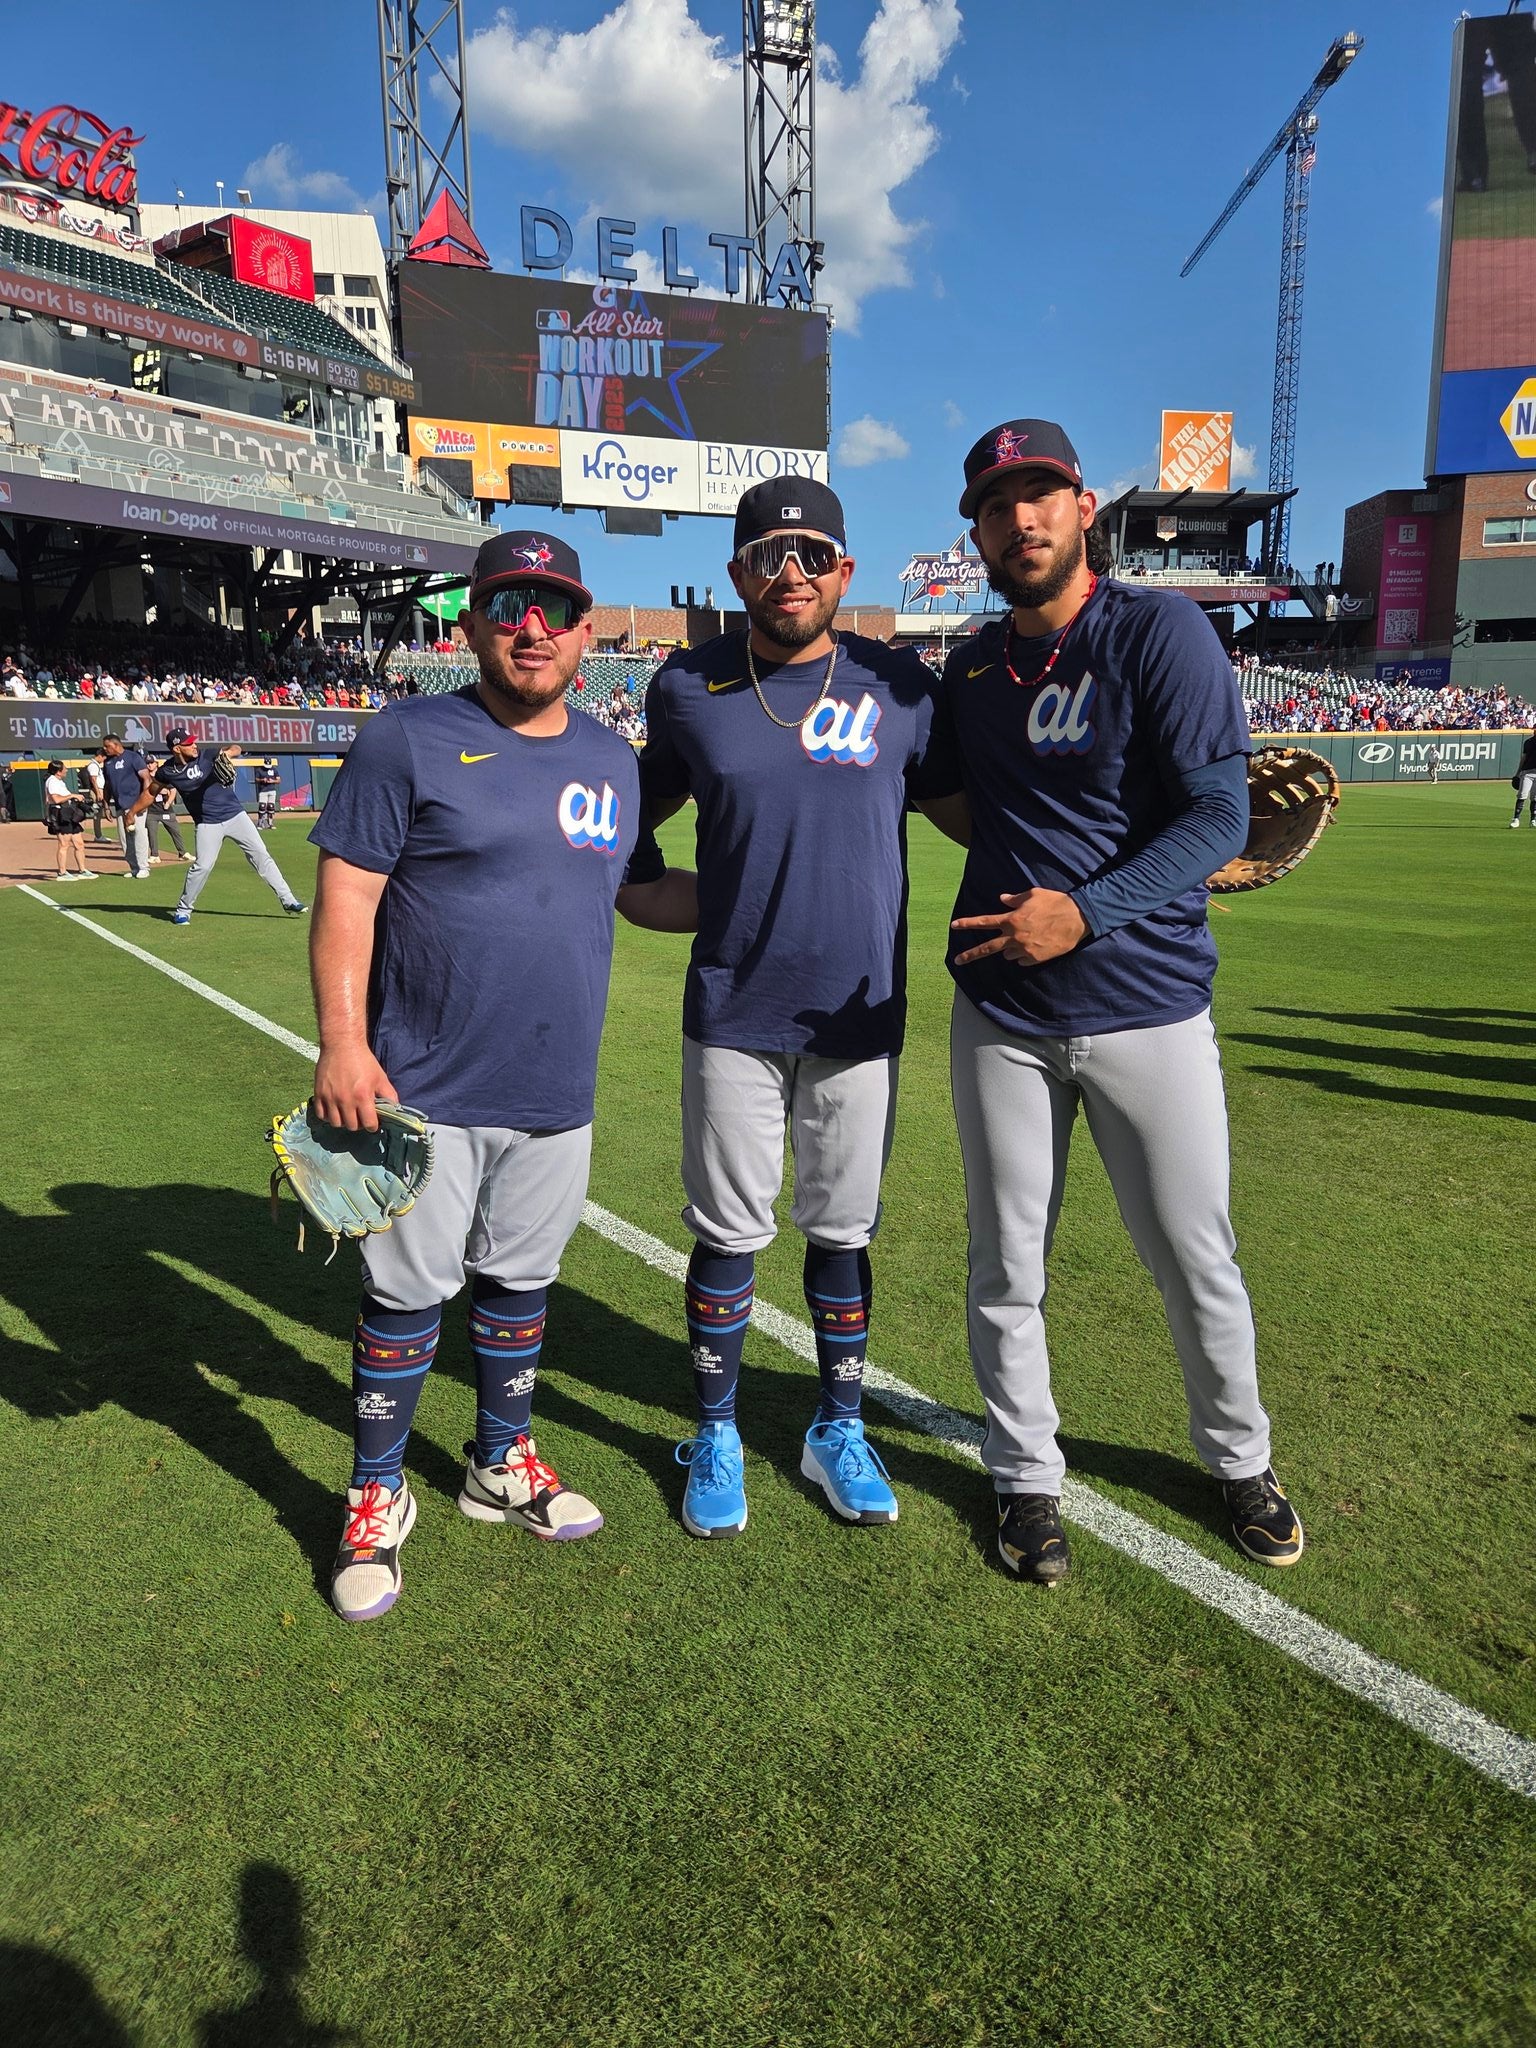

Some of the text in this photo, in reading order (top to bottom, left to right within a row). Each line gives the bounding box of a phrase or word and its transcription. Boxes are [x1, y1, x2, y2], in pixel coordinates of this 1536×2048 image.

[520, 205, 812, 302] DELTA
[0, 282, 225, 352] work is thirsty work
[263, 346, 319, 376] 6:16 PM
[538, 334, 664, 378] WORKOUT
[366, 371, 415, 400] $51,925
[535, 373, 626, 431] DAY 2025
[435, 444, 475, 454] MILLIONS
[436, 428, 475, 445] MEGA
[1162, 413, 1232, 490] HOME
[1168, 421, 1198, 453] THE
[583, 440, 678, 501] Kroger
[705, 445, 821, 480] EMORY
[1186, 443, 1230, 491] DEPOT
[123, 500, 402, 555] loanDepot OFFICIAL MORTGAGE PROVIDER OF
[1178, 521, 1227, 531] CLUBHOUSE
[1239, 588, 1268, 599] Mobile
[33, 717, 100, 739] Mobile
[317, 725, 357, 742] 2025
[801, 691, 877, 758] al
[1027, 670, 1093, 746] al
[558, 781, 619, 847] al
[351, 1549, 377, 1562] NIKE
